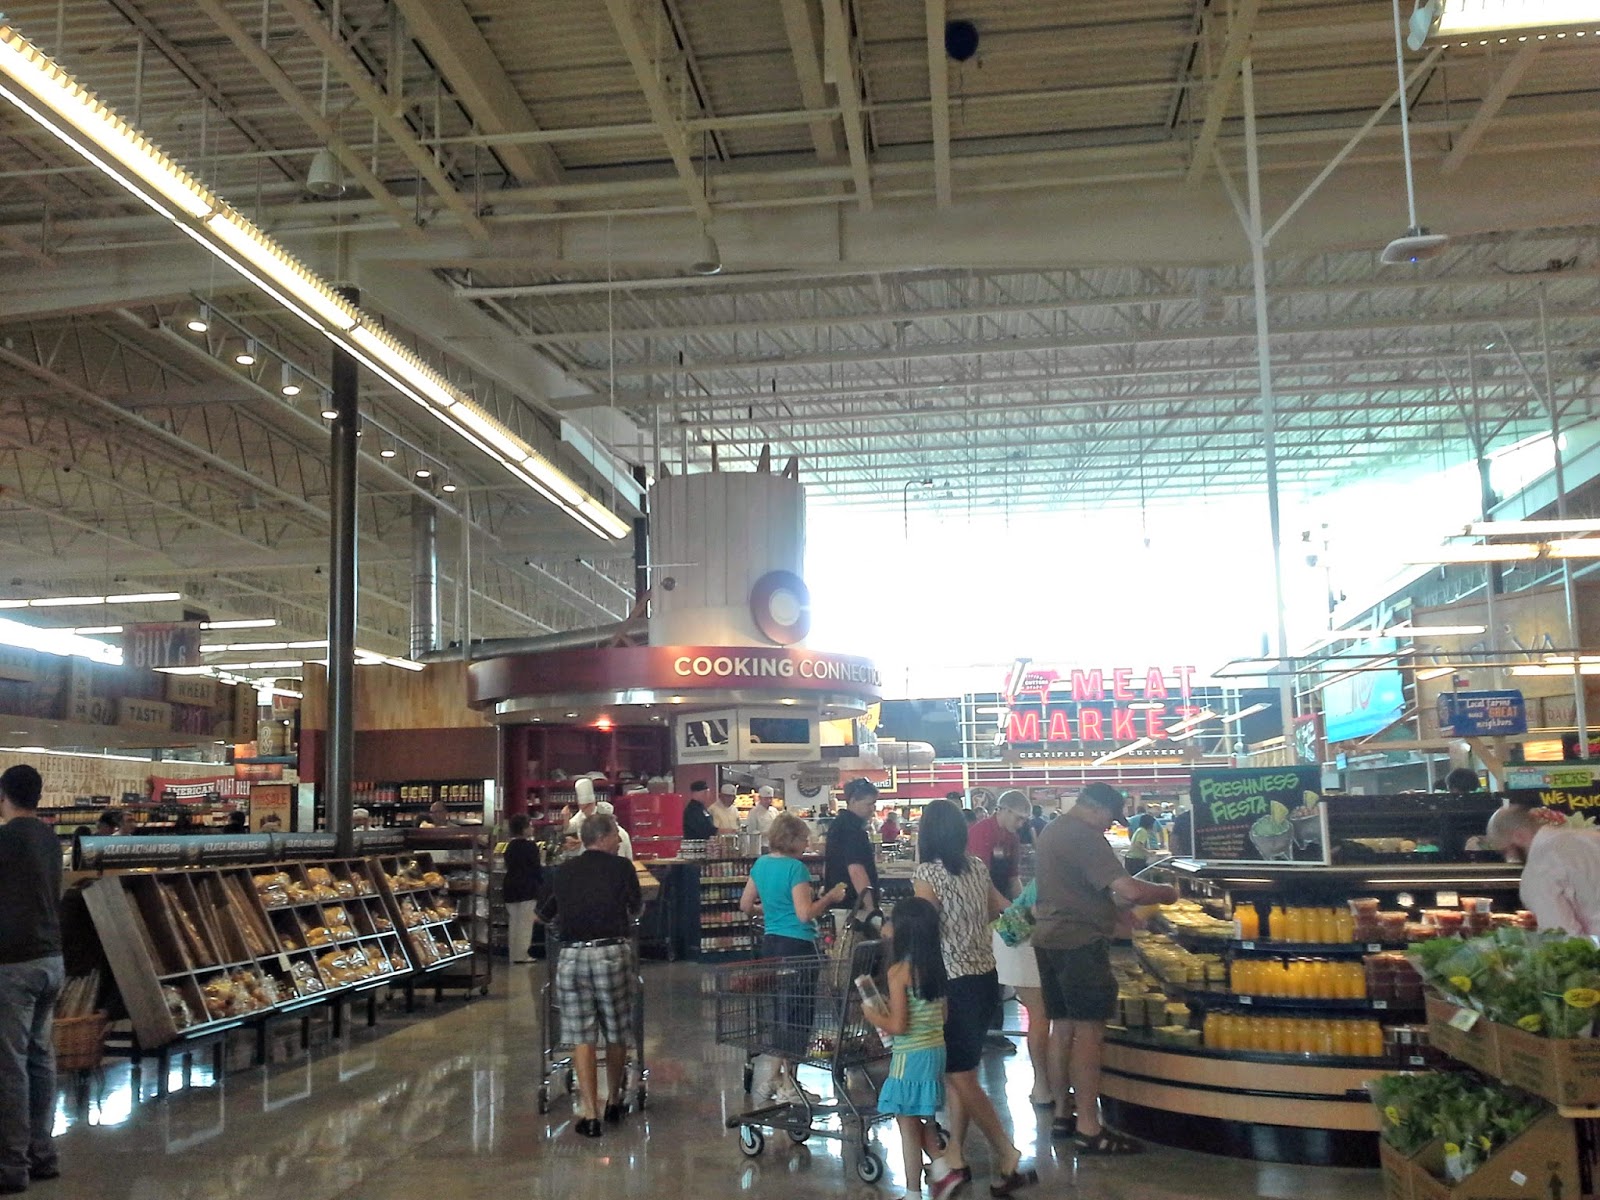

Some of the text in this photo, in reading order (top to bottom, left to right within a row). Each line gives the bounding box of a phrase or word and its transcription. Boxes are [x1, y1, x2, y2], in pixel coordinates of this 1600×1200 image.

[135, 631, 172, 667] BUY
[674, 656, 794, 677] COOKING
[1071, 666, 1196, 701] MEAT
[1466, 700, 1485, 708] Local
[1488, 706, 1518, 717] GREAT
[1006, 706, 1198, 743] MARKET
[1019, 751, 1085, 759] CERTIFIED
[1199, 773, 1299, 803] FRESHNESS
[1540, 790, 1567, 806] WE
[1210, 796, 1269, 825] FIESTA
